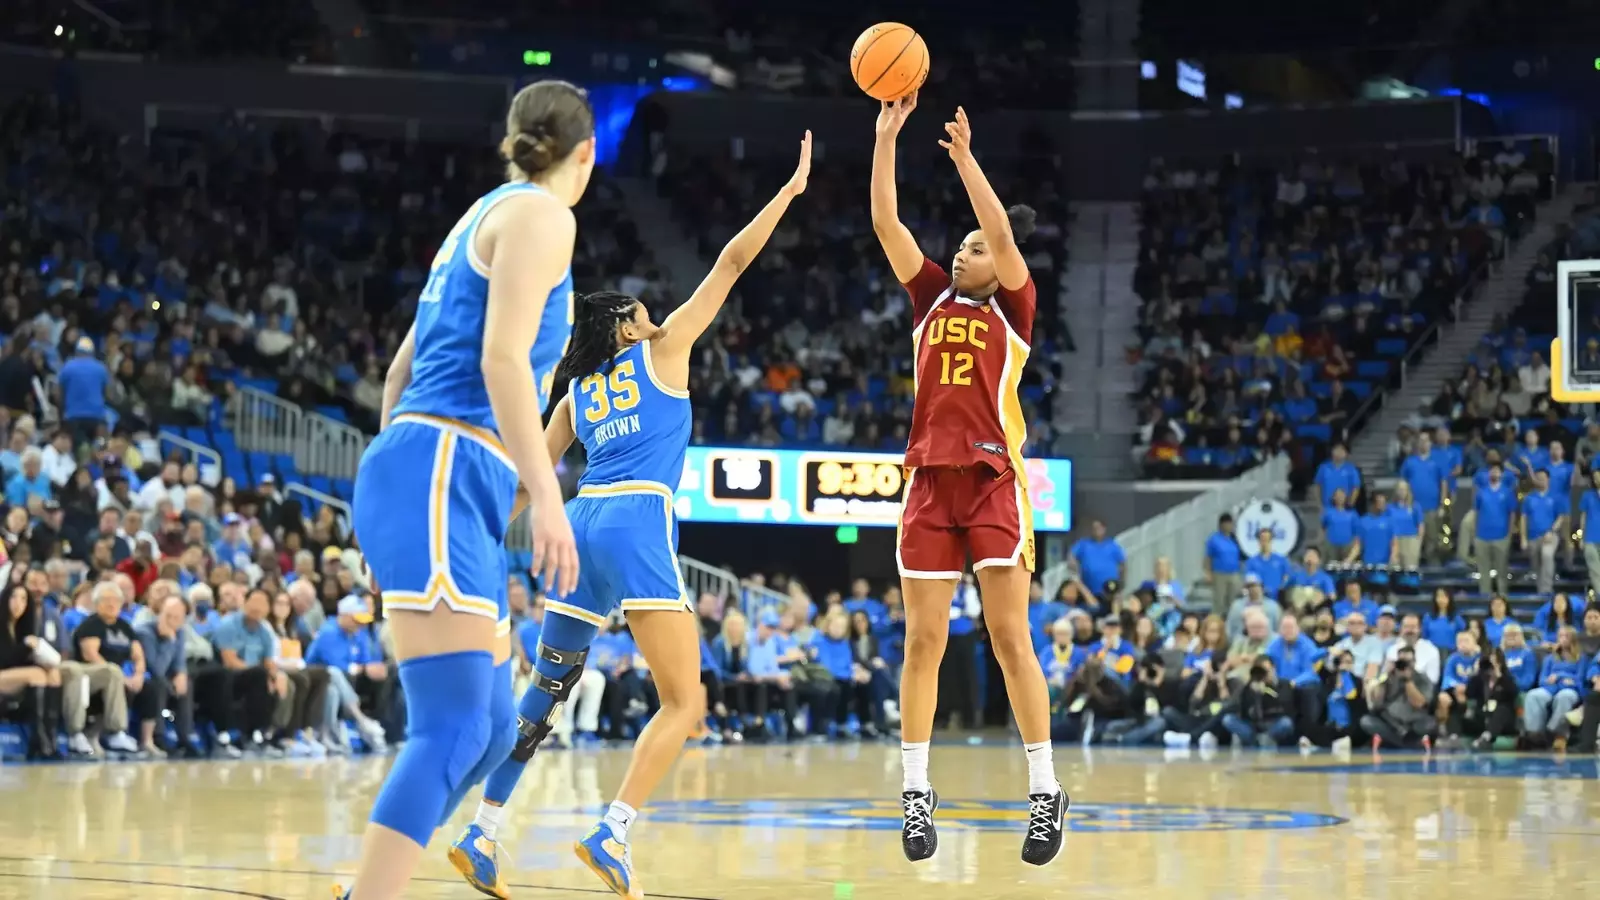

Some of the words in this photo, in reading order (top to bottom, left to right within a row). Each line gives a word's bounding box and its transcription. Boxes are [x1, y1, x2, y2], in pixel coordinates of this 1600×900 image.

[928, 316, 989, 351] USC
[939, 351, 974, 386] 12
[580, 358, 642, 424] 35
[594, 413, 641, 446] BROWN
[817, 461, 902, 497] 9:30
